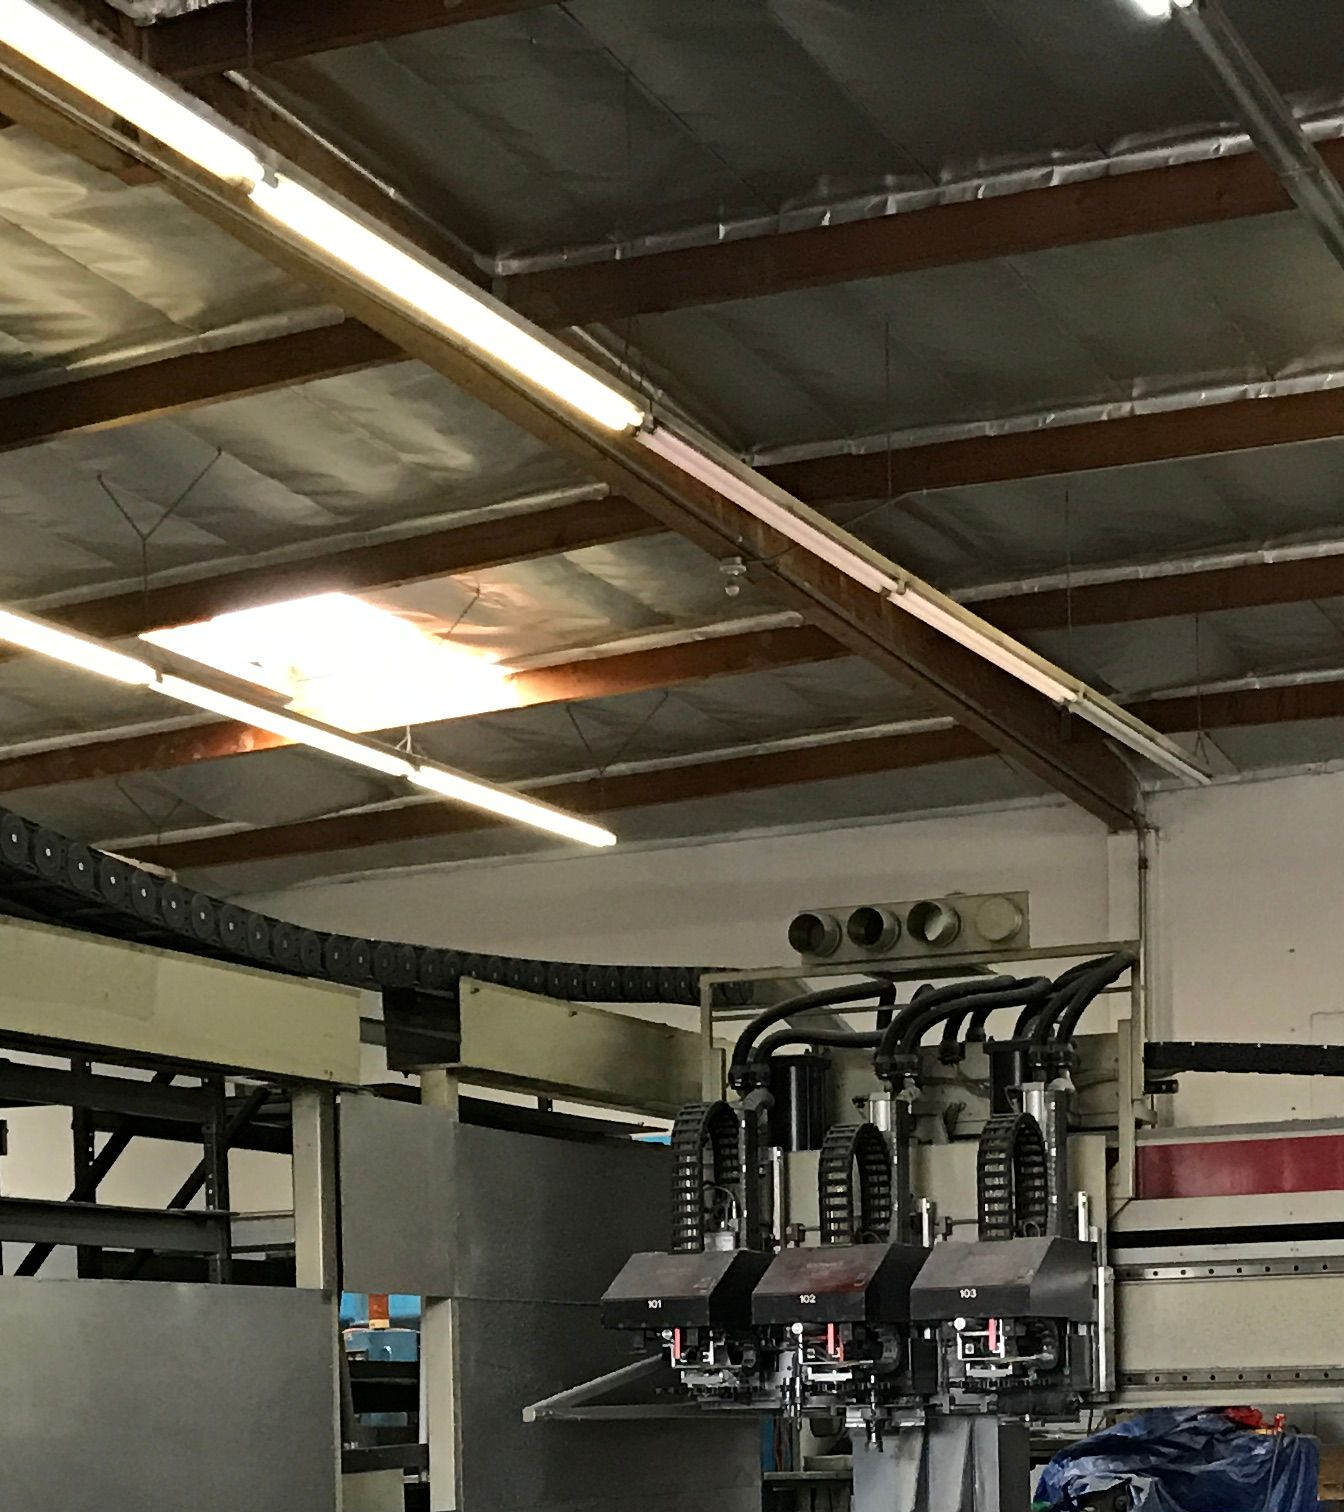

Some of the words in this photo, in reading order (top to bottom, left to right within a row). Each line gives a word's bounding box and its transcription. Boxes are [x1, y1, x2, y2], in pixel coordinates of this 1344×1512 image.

[959, 1288, 978, 1299] 103
[799, 1294, 816, 1304] 102
[648, 1300, 662, 1309] 101
